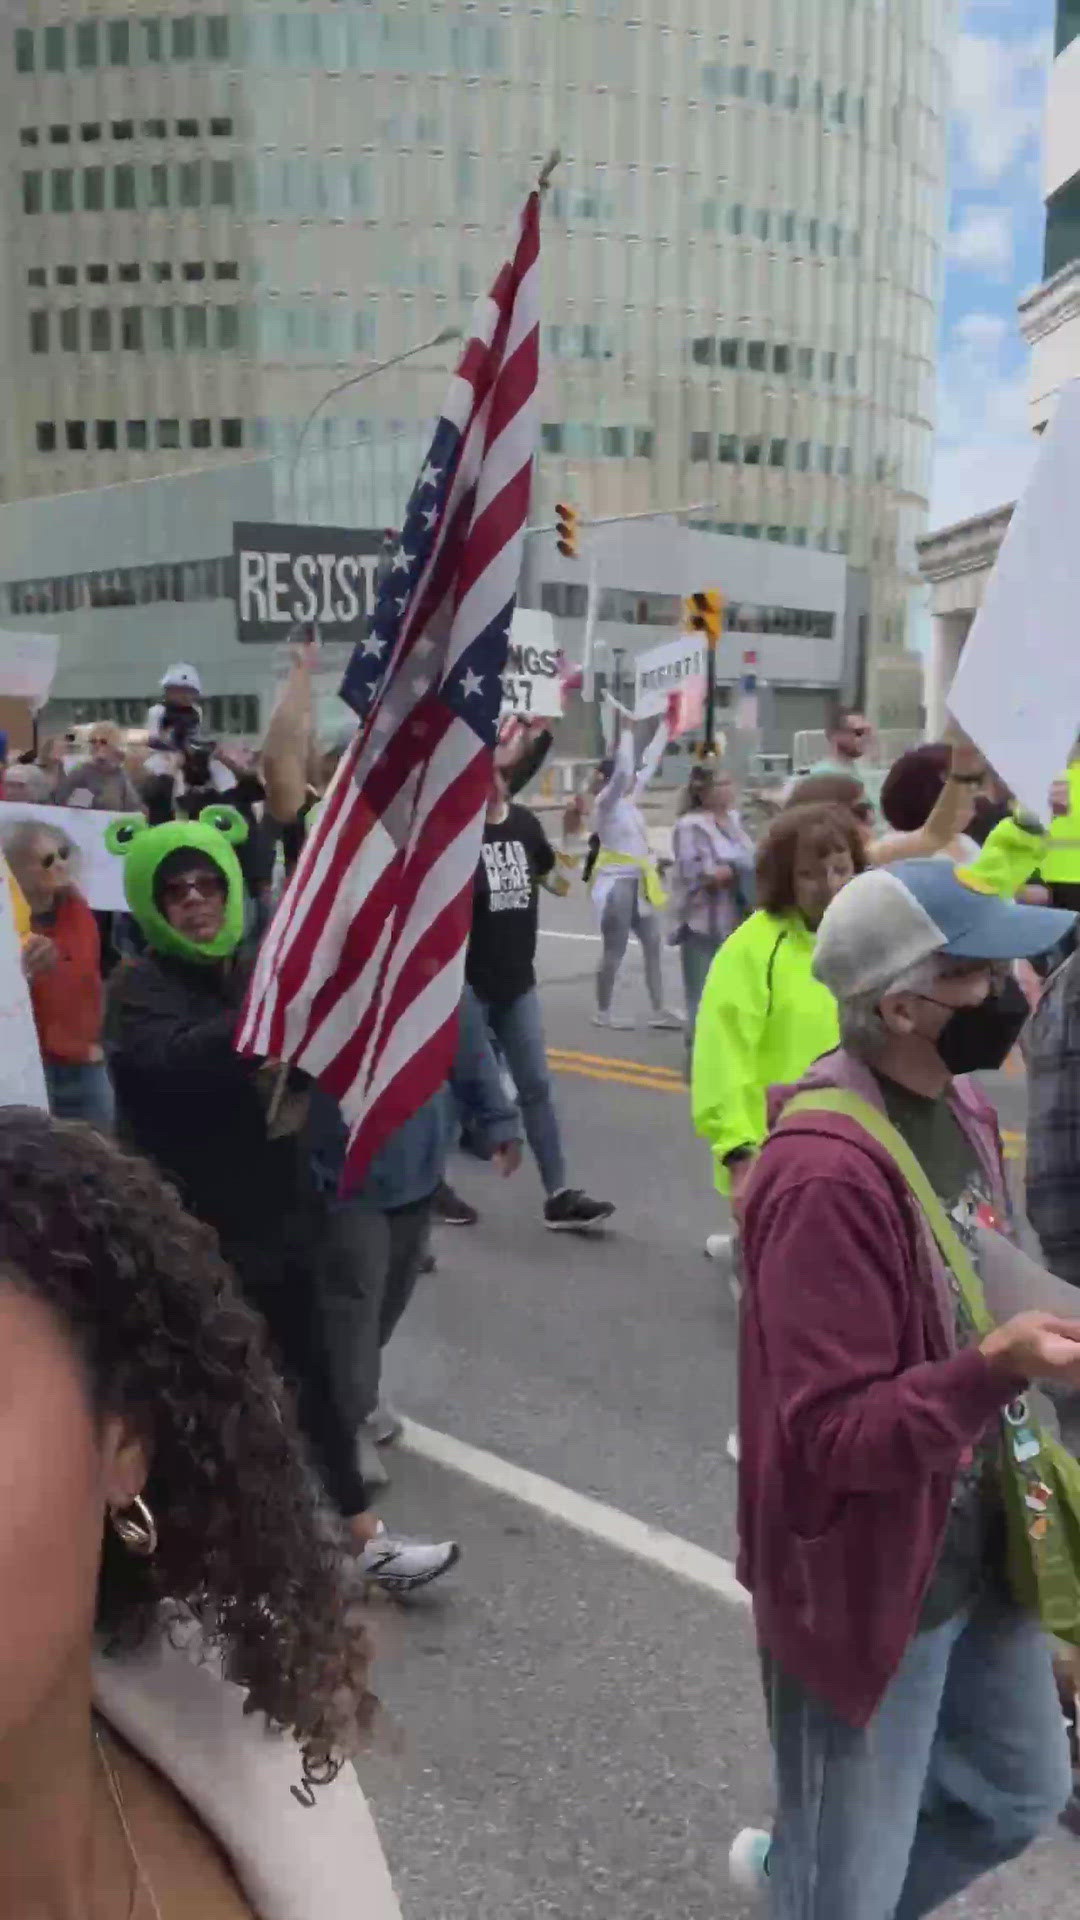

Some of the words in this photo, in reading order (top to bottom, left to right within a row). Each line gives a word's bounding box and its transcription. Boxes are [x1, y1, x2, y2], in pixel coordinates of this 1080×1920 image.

[239, 550, 379, 622] RESIST
[509, 644, 558, 678] NGS
[481, 840, 528, 868] READ
